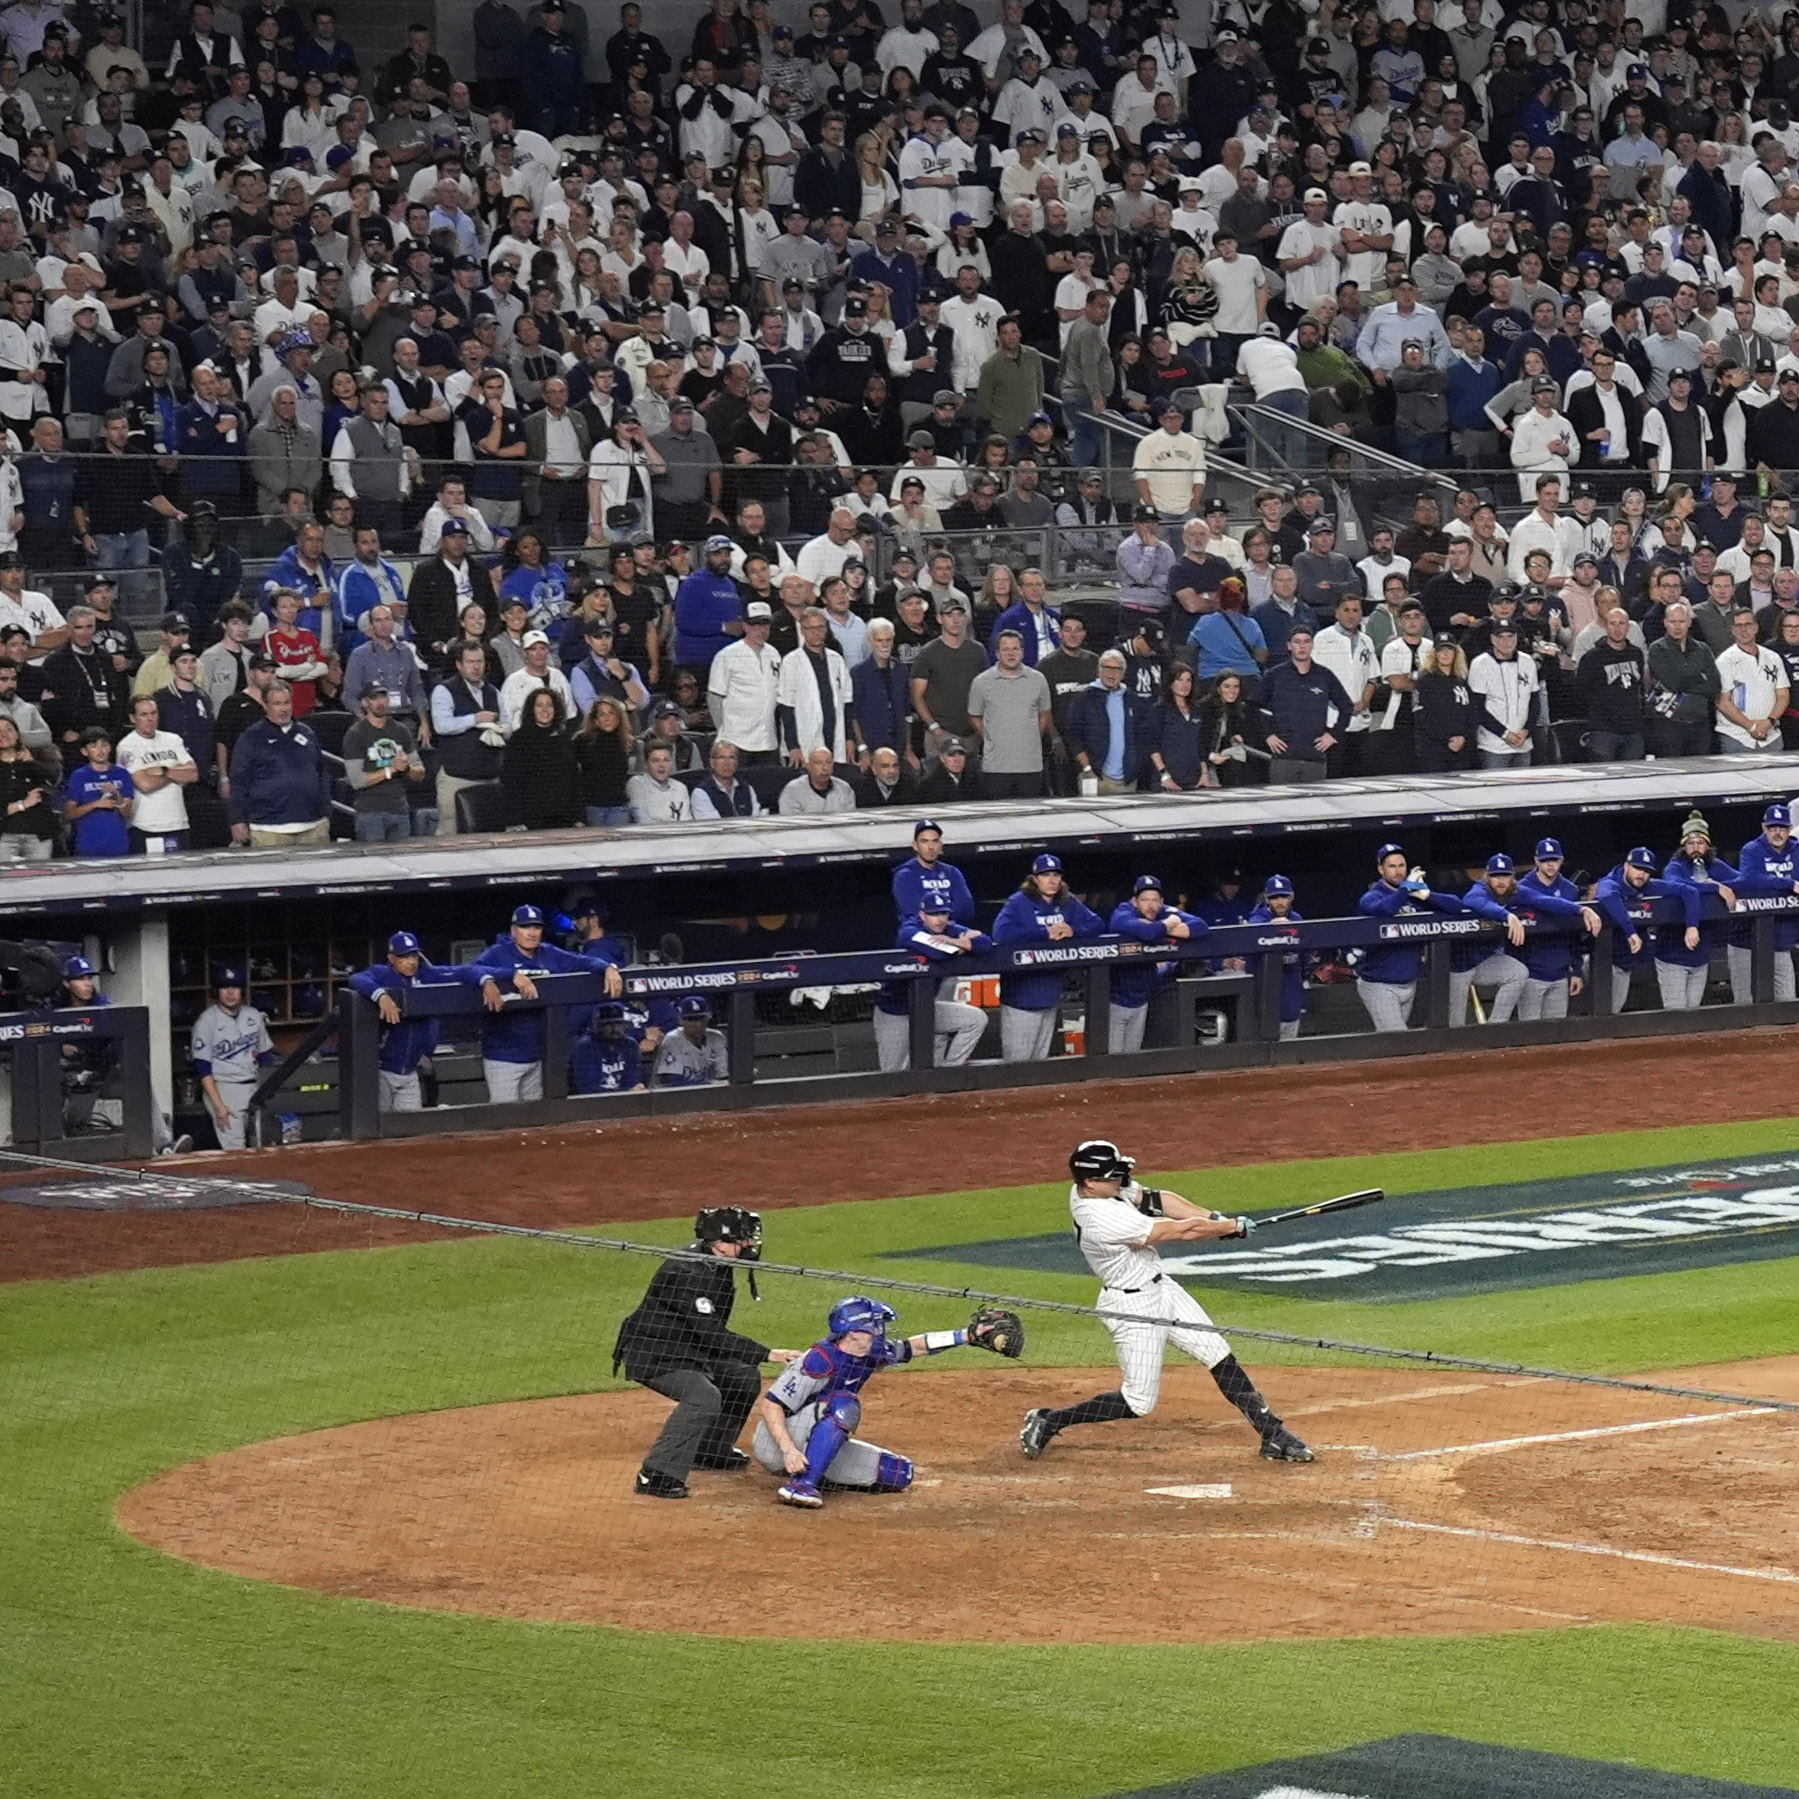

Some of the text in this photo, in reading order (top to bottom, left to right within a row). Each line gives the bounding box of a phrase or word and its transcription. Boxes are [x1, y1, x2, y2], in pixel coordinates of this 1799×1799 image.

[28, 191, 55, 223] NY
[1747, 896, 1786, 911] WORLD
[1400, 922, 1441, 937] WORLD
[1442, 919, 1480, 933] SERIES
[1034, 948, 1077, 963] WORLD
[1078, 945, 1119, 959] SERIES
[649, 975, 694, 992] WORLD
[695, 971, 737, 988] SERIES
[782, 1376, 796, 1397] LA
